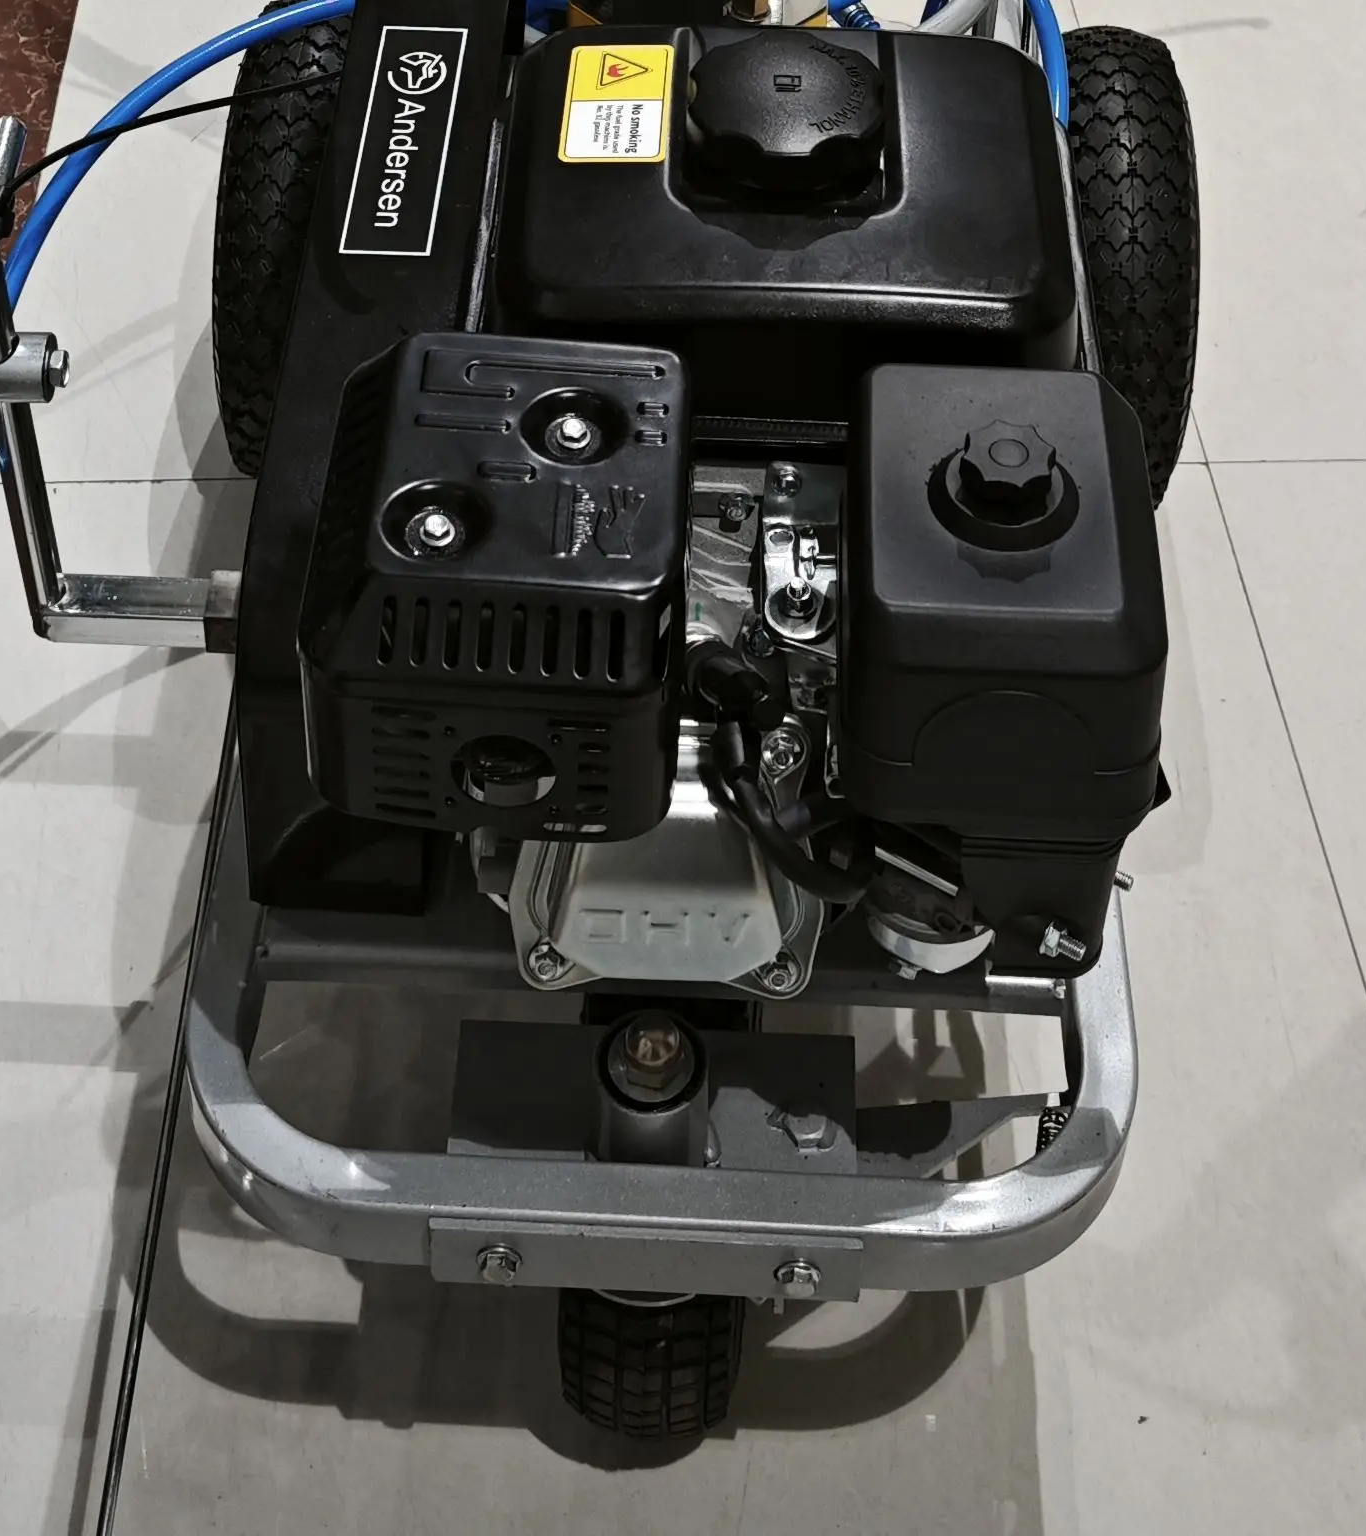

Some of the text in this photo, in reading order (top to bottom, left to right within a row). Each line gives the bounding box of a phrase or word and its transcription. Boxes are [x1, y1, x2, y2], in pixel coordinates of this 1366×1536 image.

[625, 104, 643, 153] No smoking
[374, 98, 425, 227] Andersen
[578, 906, 750, 948] OHV
